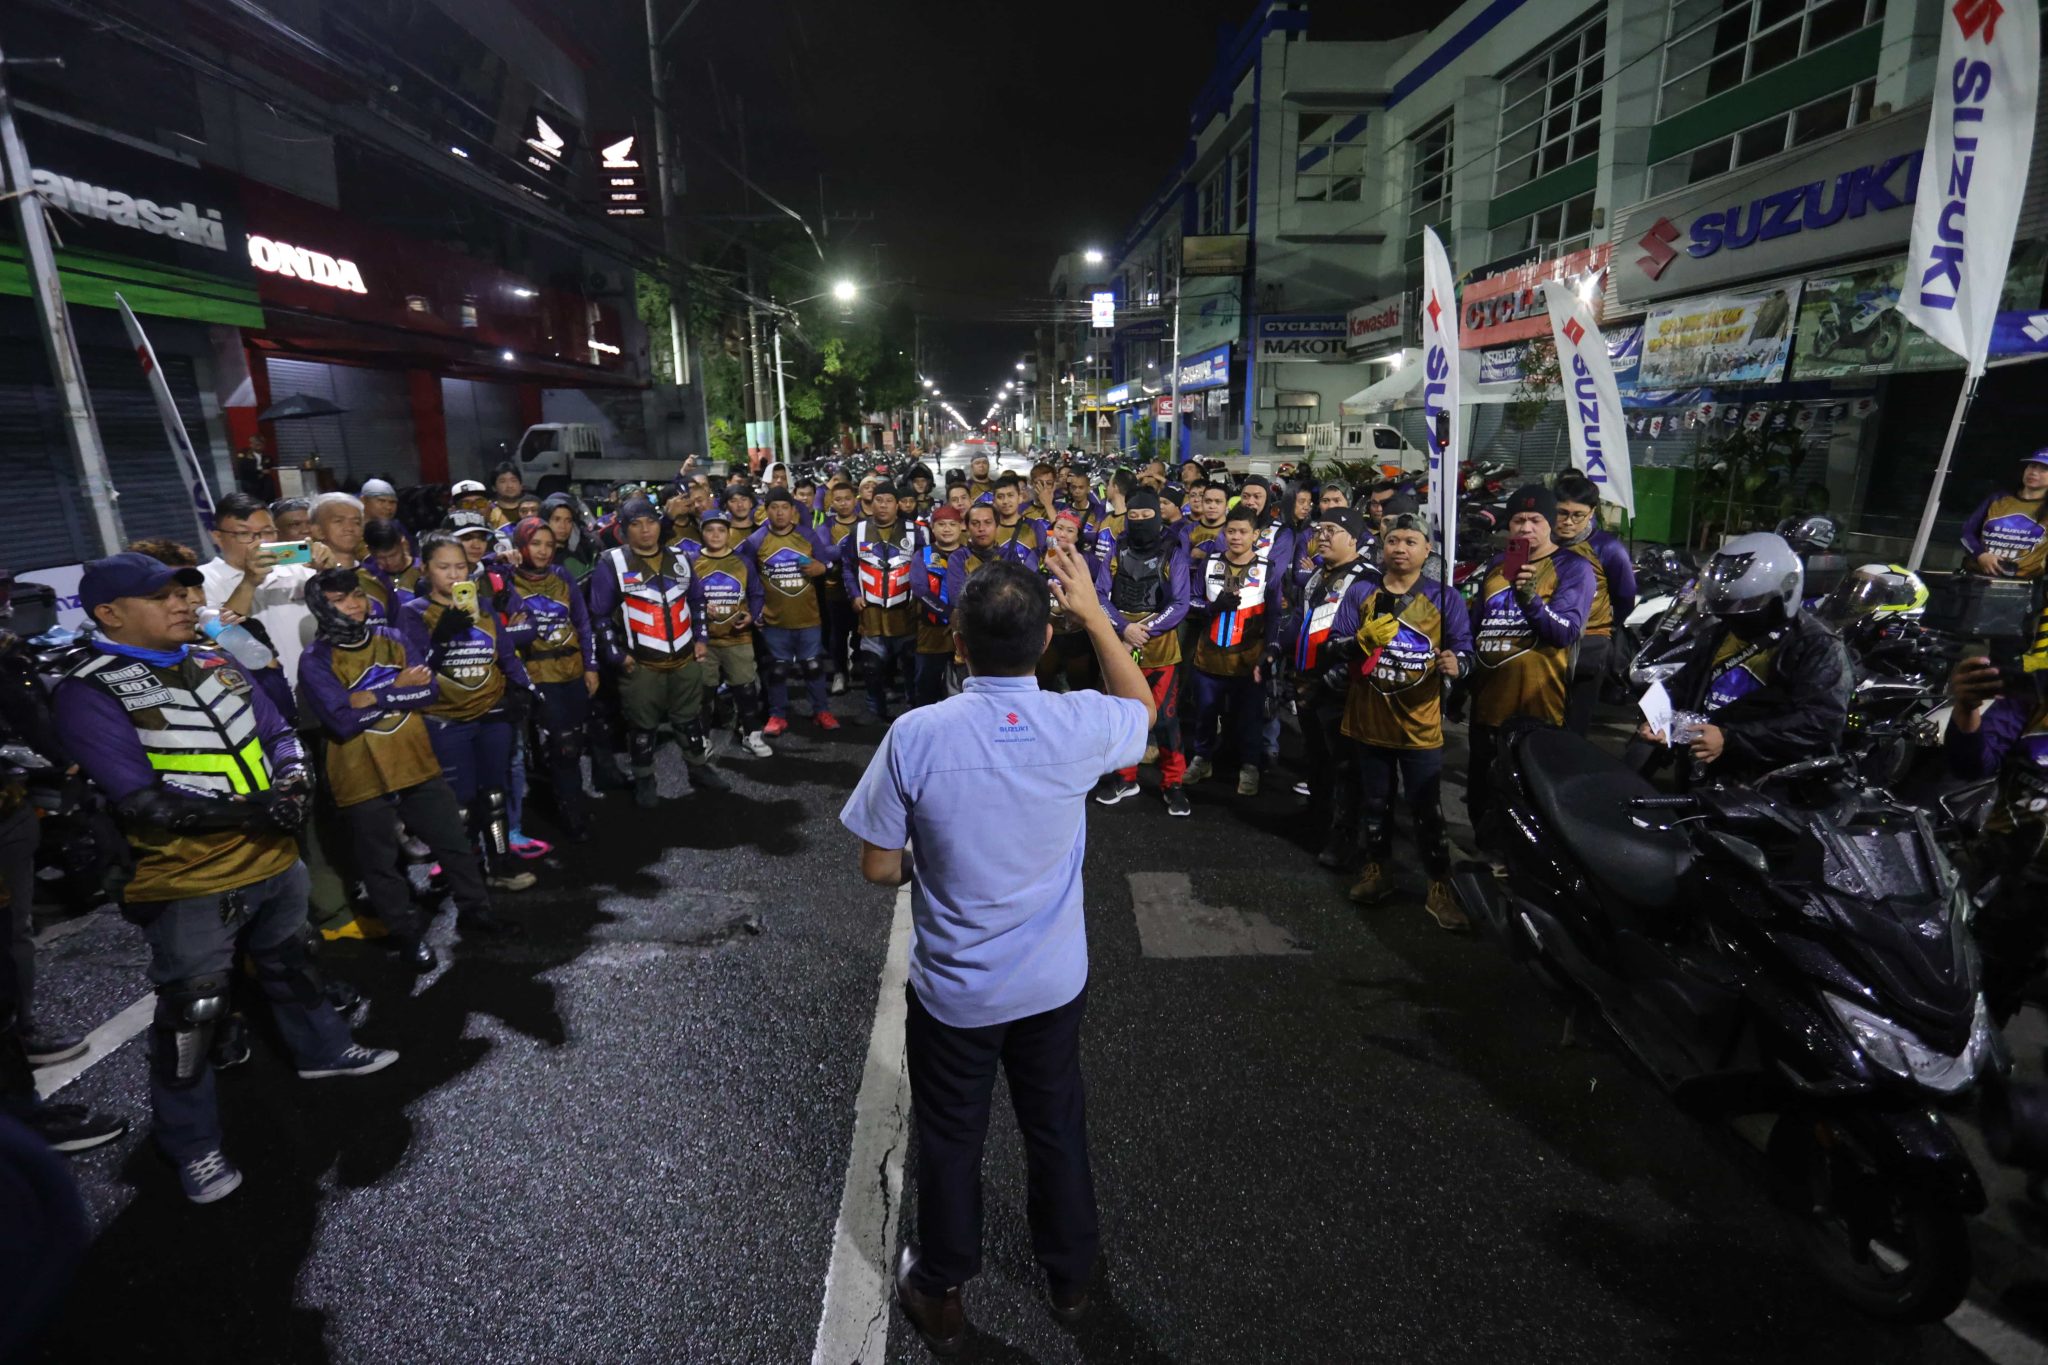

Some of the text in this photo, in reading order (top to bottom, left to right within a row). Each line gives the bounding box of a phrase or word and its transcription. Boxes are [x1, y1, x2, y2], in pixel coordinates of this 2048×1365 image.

[1919, 57, 1992, 310] SUZUKI
[32, 168, 228, 252] awasaki
[1686, 149, 1924, 259] SUZUKI
[245, 233, 368, 294] ONDA
[1350, 304, 1399, 338] Kawasaki
[1572, 353, 1608, 484] SUZUKI
[1480, 640, 1512, 652] 2025
[119, 679, 152, 693] 001
[453, 667, 485, 678] 2025
[397, 689, 431, 701] SUZUKI
[999, 725, 1028, 733] SUZUKI
